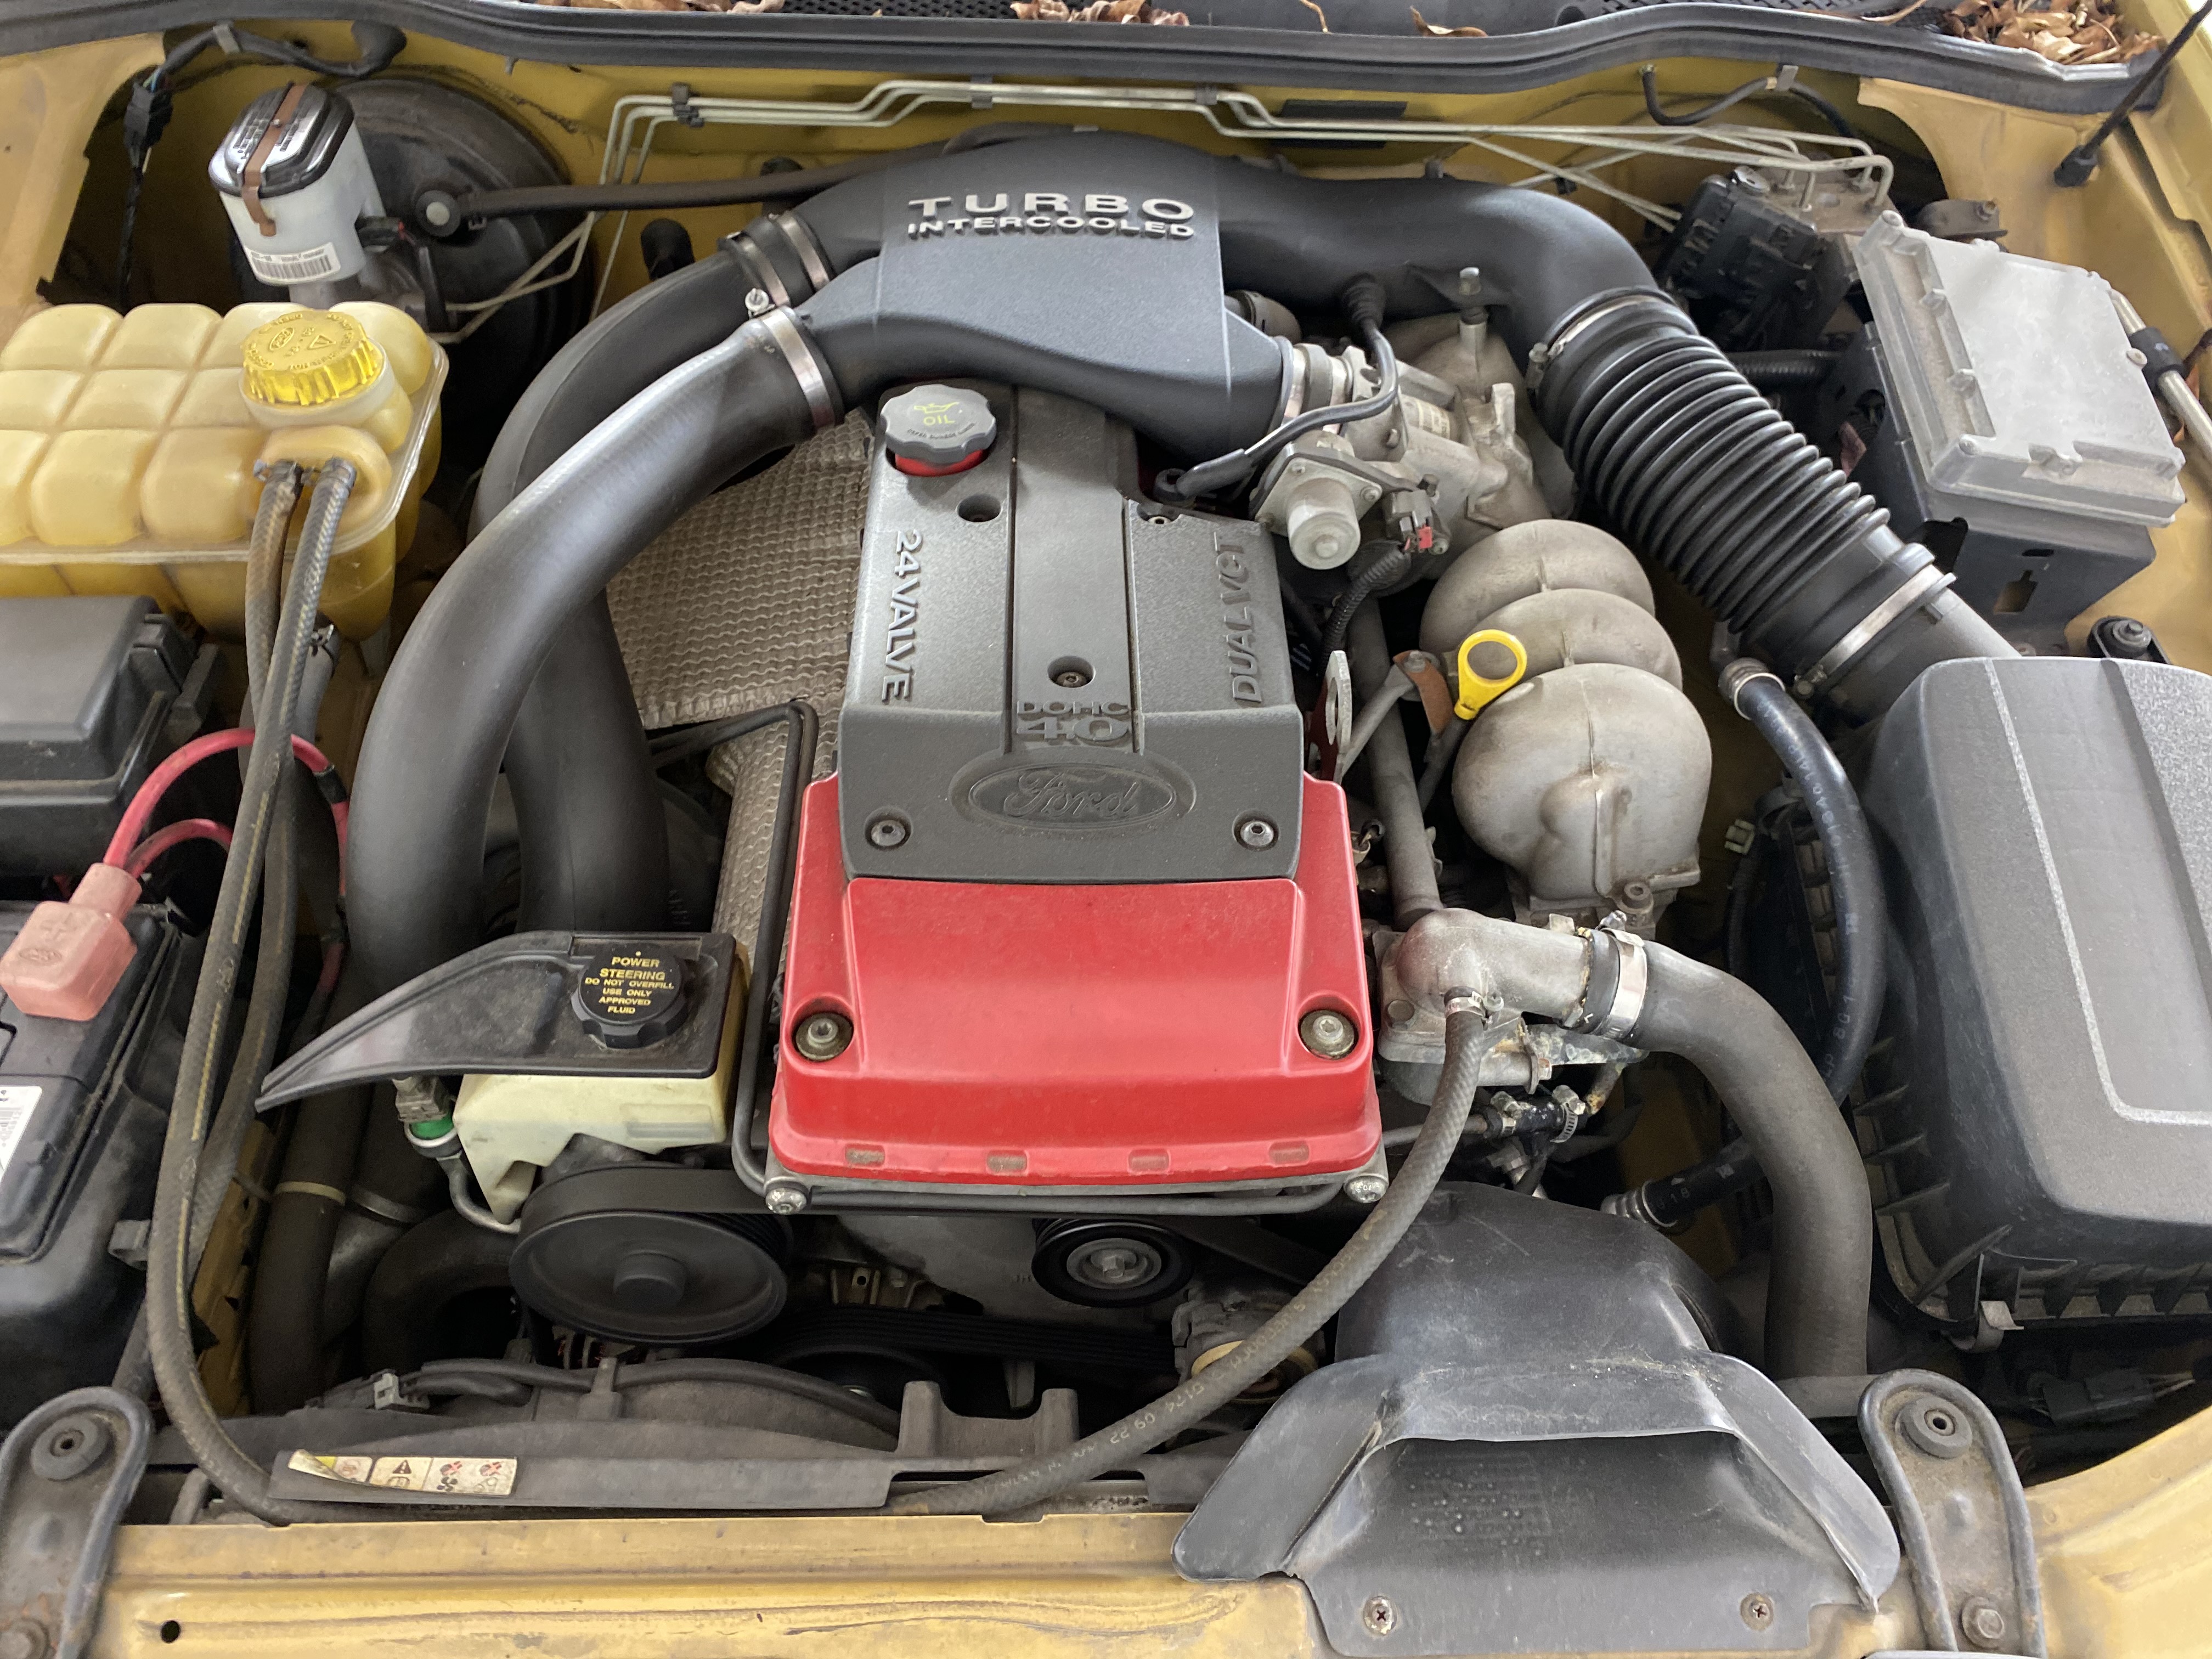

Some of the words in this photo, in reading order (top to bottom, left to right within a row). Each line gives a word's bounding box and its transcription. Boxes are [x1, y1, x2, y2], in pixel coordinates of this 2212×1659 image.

[908, 193, 1194, 221] TURBO
[908, 217, 1194, 239] INTERCOOLED
[923, 415, 955, 426] OIL
[1222, 606, 1262, 703] DUAL
[1017, 701, 1130, 715] DOHC
[1003, 771, 1141, 817] Ford
[611, 956, 659, 967] POWER
[600, 968, 665, 980] STEERING
[584, 977, 600, 986] DO
[629, 980, 674, 989] OVERFILL
[602, 988, 623, 996] USE
[627, 989, 652, 997] ONLY
[599, 996, 652, 1006] APPROVED
[607, 1006, 636, 1014] FLUID
[1134, 1412, 1156, 1430] 09
[1110, 1428, 1130, 1444] 22
